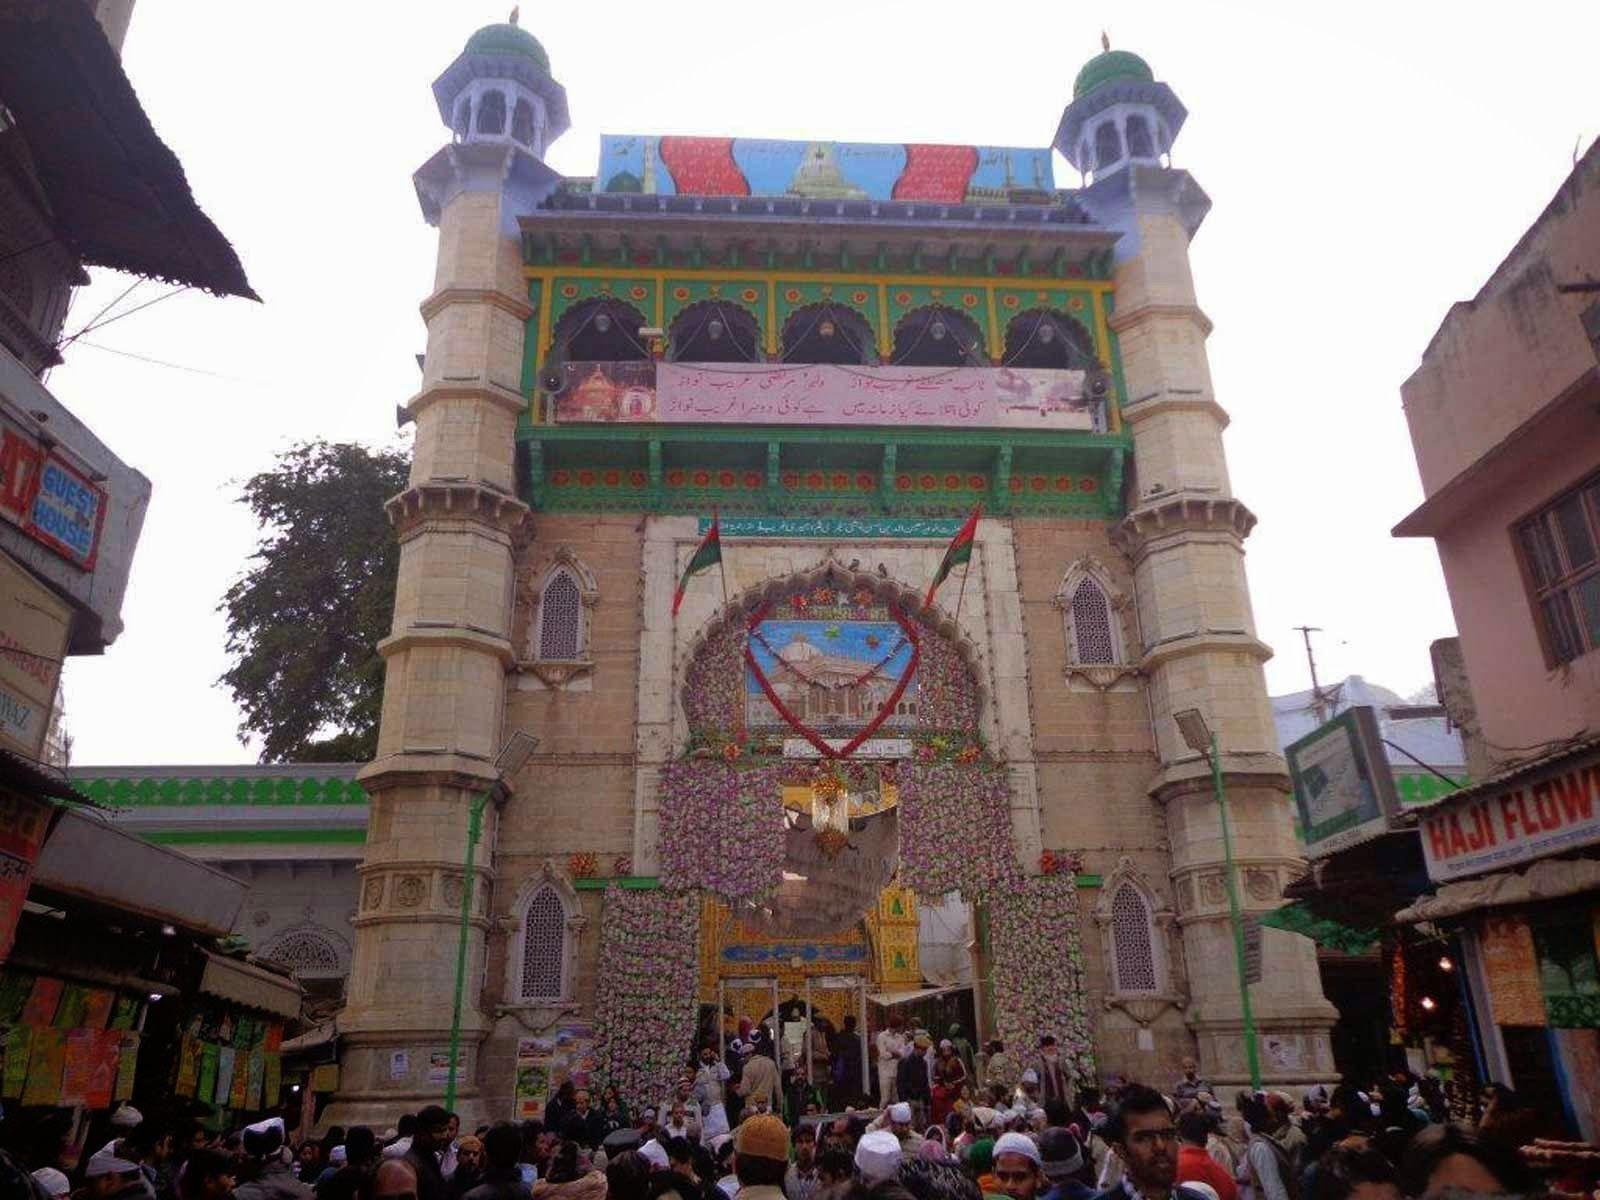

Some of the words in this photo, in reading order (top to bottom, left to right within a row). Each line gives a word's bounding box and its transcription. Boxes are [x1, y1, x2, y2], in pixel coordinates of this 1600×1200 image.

[43, 463, 99, 518] GUEST
[32, 496, 93, 553] HOUSE
[1428, 804, 1497, 861] HAJI
